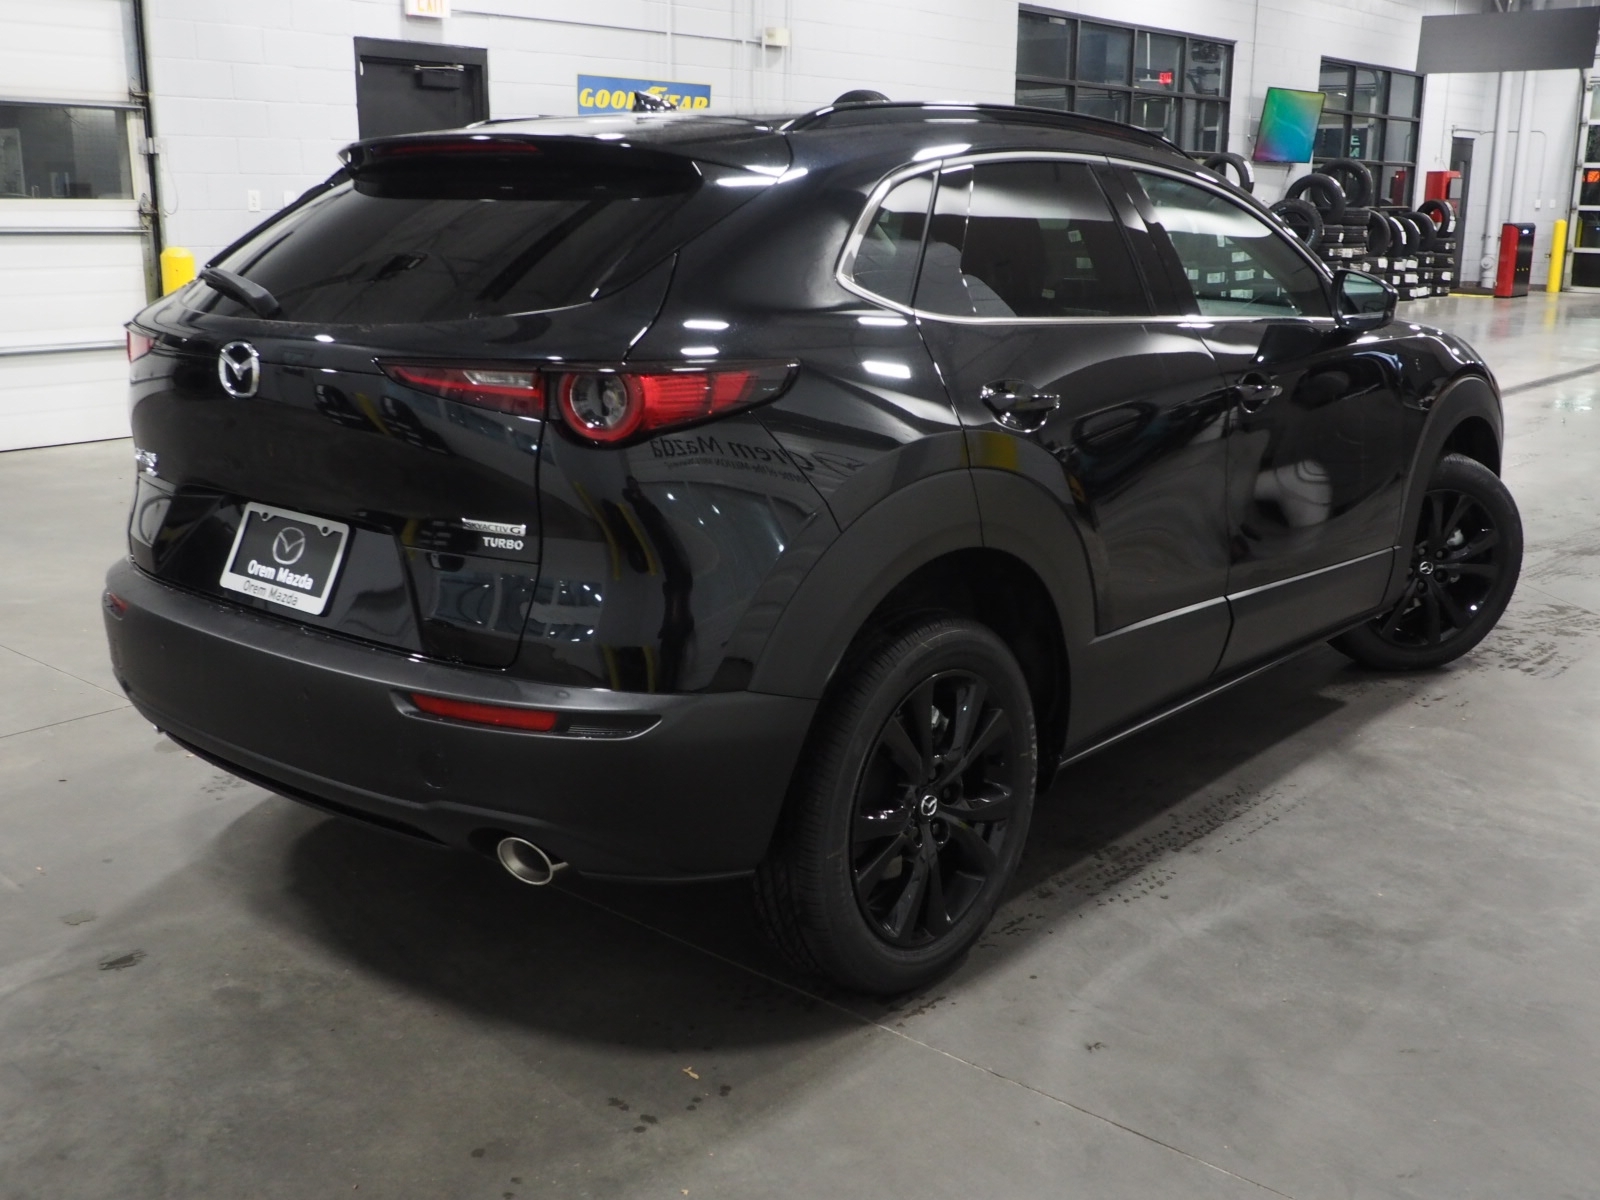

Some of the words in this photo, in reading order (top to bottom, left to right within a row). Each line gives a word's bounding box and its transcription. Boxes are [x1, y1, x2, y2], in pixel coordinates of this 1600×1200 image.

[580, 87, 708, 110] GOOEAR
[482, 536, 524, 551] TURBO
[247, 560, 276, 580] Orem
[276, 567, 314, 590] Mazda
[243, 580, 266, 596] Orem
[268, 586, 298, 606] Mazda
